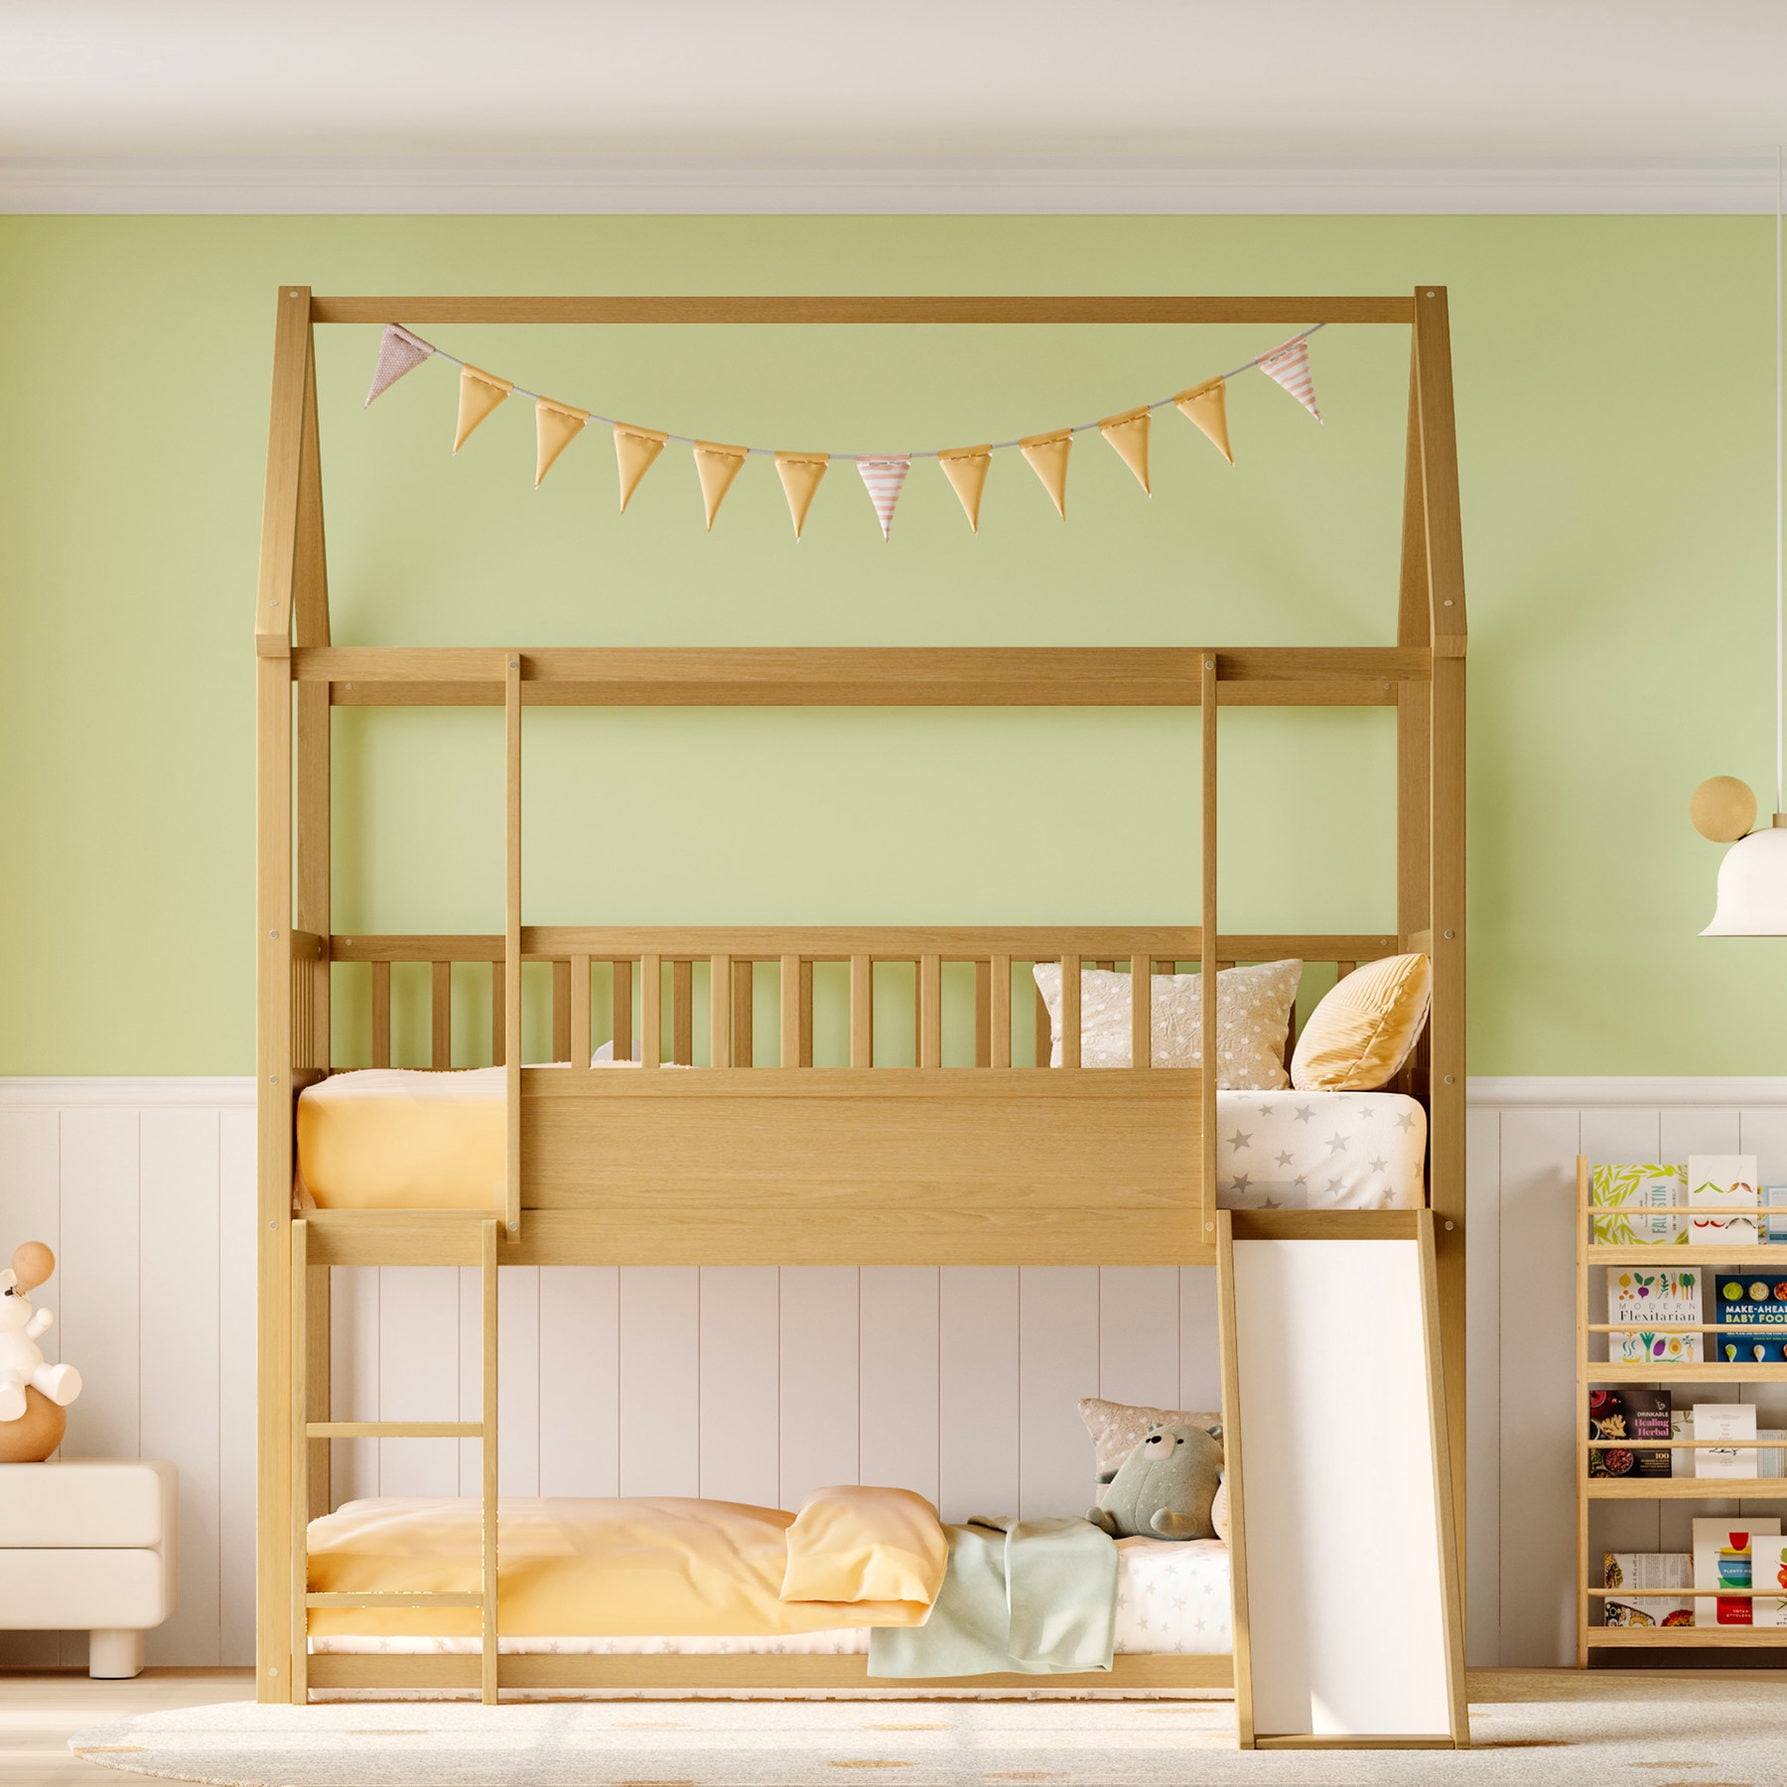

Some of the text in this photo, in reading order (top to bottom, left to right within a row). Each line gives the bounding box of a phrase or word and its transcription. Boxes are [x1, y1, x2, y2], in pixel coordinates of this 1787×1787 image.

[1651, 1185, 1667, 1234] FALSTIN
[1620, 1310, 1696, 1321] Flexitarian
[1725, 1314, 1755, 1323] BABY
[1634, 1418, 1670, 1428] Healing
[1638, 1428, 1669, 1436] Herbal
[1655, 1452, 1670, 1460] 100
